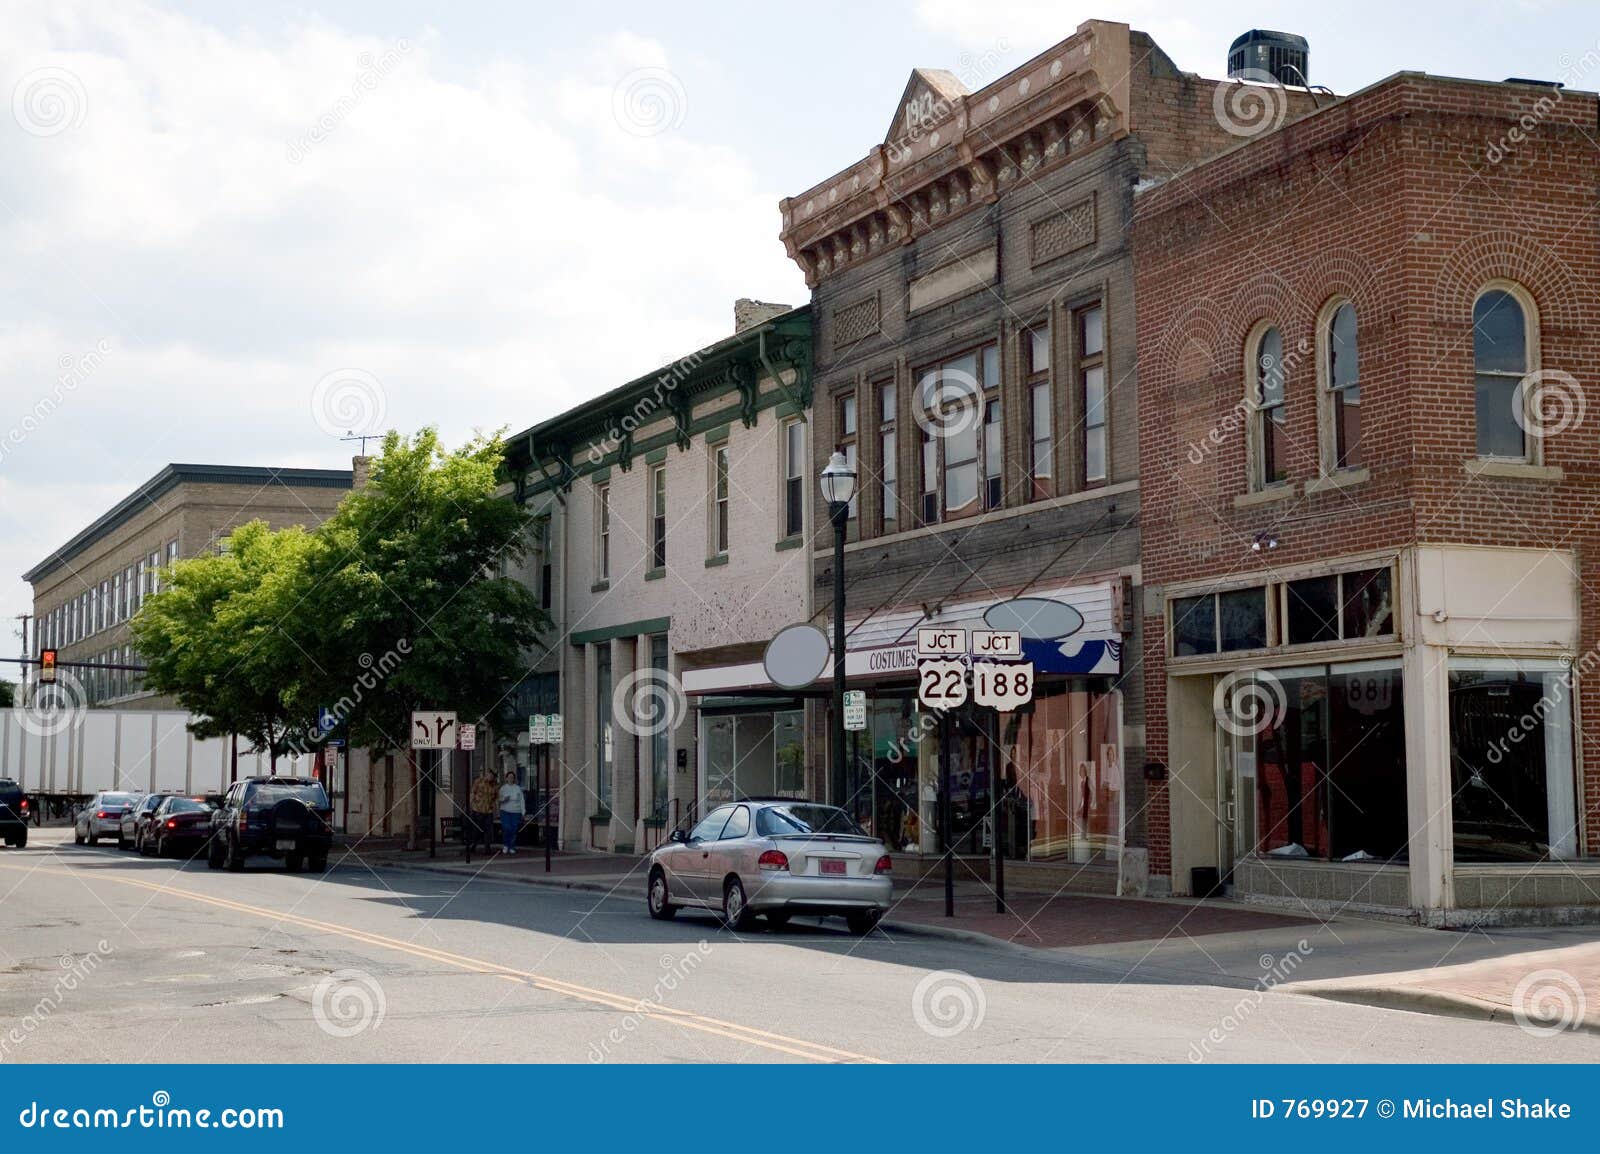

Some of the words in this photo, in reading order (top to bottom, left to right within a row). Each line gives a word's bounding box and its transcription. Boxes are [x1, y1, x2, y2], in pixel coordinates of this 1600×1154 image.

[927, 634, 958, 649] JCT
[981, 636, 1012, 650] JCT
[870, 649, 916, 671] COSTUMES
[923, 670, 962, 698] 22
[979, 672, 1028, 697] 188
[413, 738, 431, 746] ONLY
